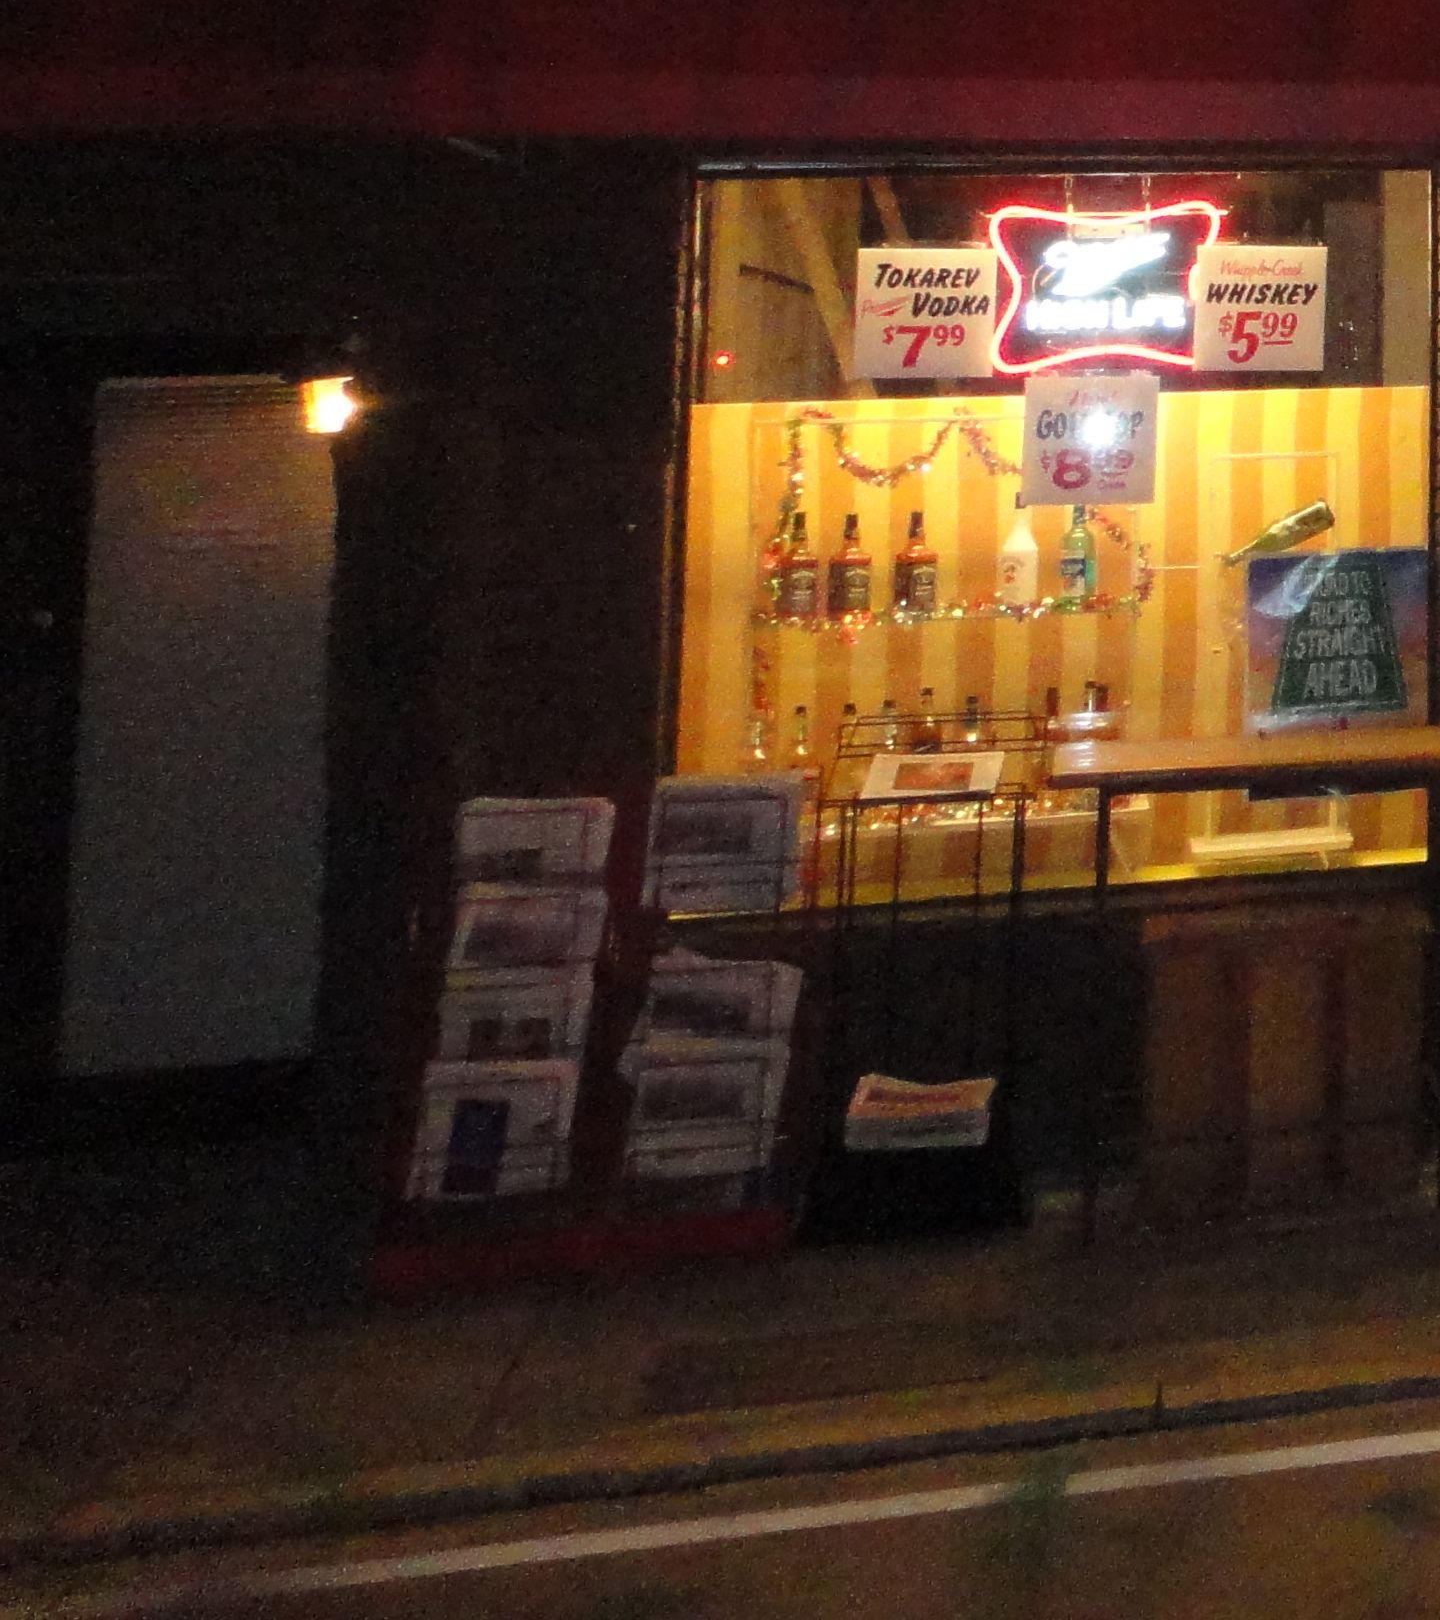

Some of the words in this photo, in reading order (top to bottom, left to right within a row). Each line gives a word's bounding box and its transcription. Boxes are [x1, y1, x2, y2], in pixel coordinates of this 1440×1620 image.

[874, 263, 981, 289] TOKAREV
[911, 291, 991, 318] VODKA
[1206, 282, 1318, 305] WHISKEY
[1303, 658, 1378, 698] AHEAD
